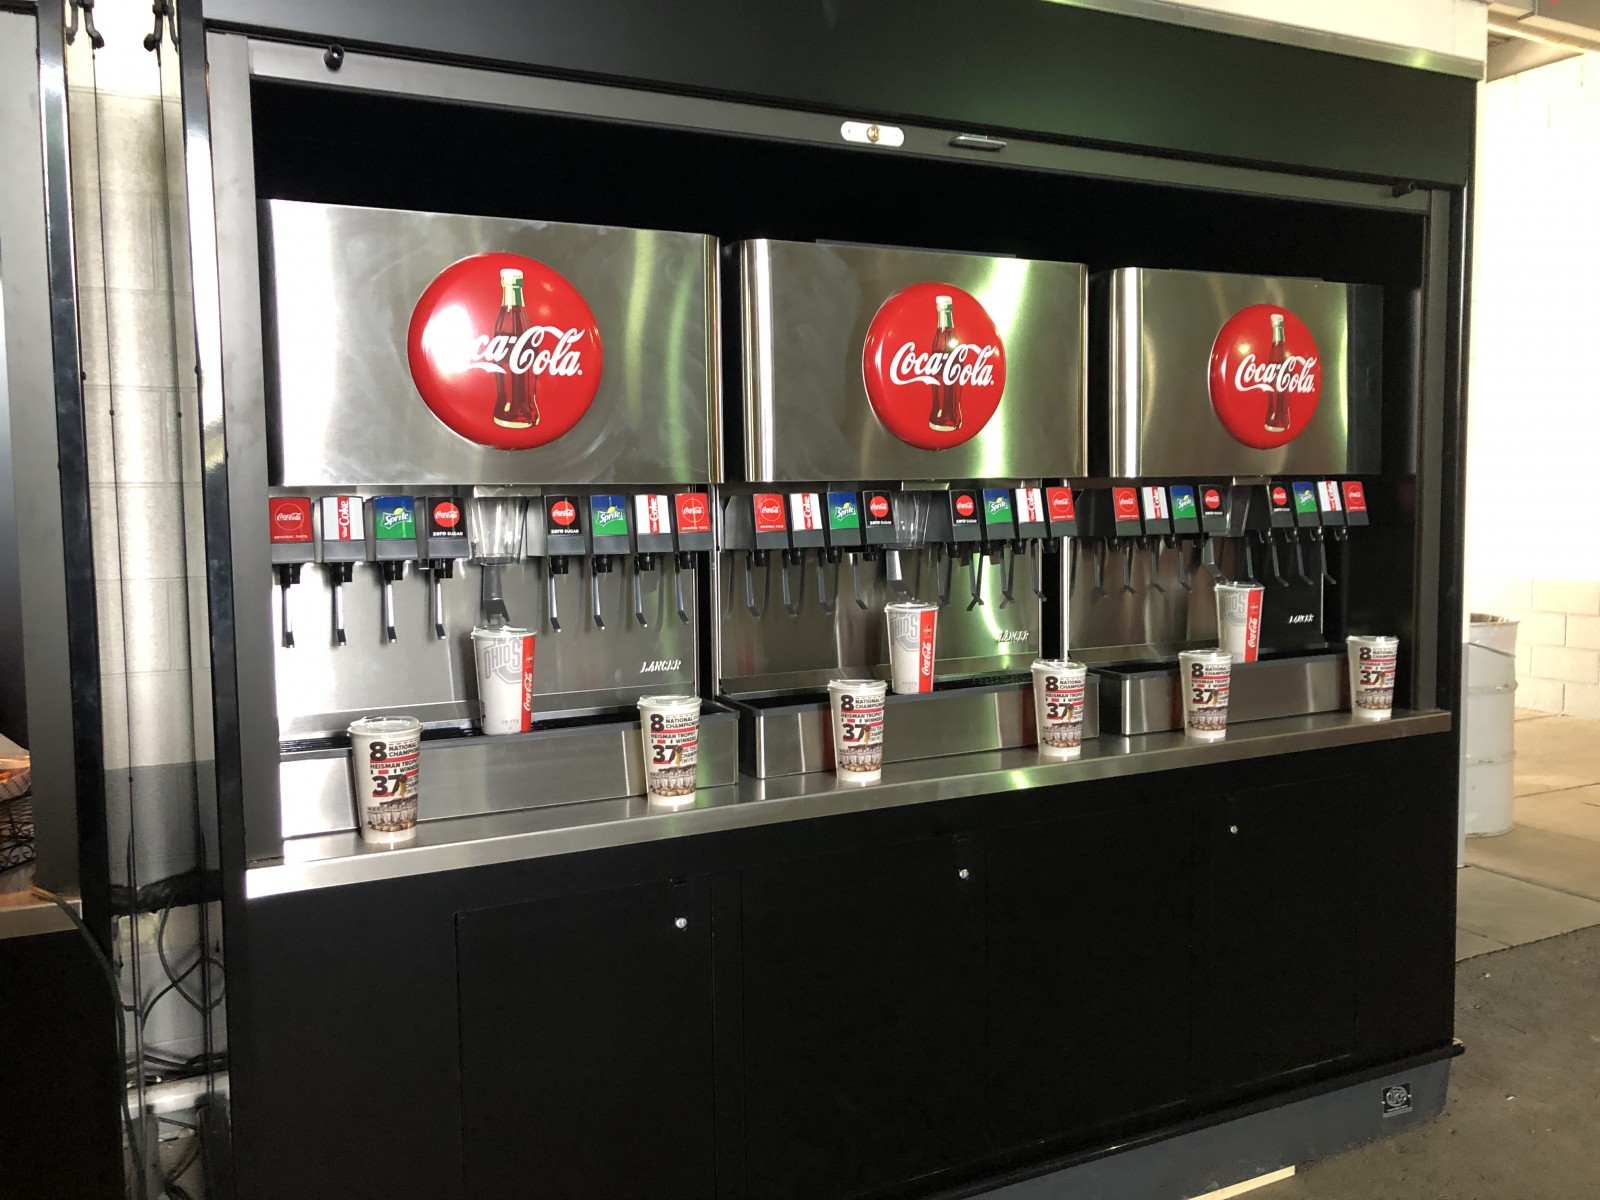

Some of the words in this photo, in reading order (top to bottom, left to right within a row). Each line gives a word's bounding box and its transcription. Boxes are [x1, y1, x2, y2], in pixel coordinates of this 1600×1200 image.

[469, 325, 586, 377] ca-Cola
[889, 341, 997, 387] Coca-Cola
[1234, 353, 1317, 393] Coca-Cola
[339, 500, 350, 526] Coke
[803, 495, 812, 518] Coke
[836, 507, 855, 518] Sprite
[990, 501, 1007, 512] Sprite
[276, 512, 302, 521] Coca-Cola
[384, 511, 409, 526] Sprite
[599, 511, 621, 523] Sprite
[1360, 647, 1371, 660] 8
[484, 644, 511, 680] OHIO
[640, 659, 682, 673] LANCER
[1192, 663, 1204, 676] 8
[1045, 676, 1058, 691] 8
[1360, 670, 1382, 684] 37
[523, 672, 533, 712] Coca-Cola
[1193, 688, 1216, 702] 37
[841, 694, 854, 711] 8
[1046, 702, 1071, 718] 37
[650, 713, 664, 731] 8
[842, 723, 868, 740] 37
[369, 741, 387, 761] 8
[389, 742, 417, 751] NATIONAL
[652, 744, 679, 762] 37
[372, 774, 403, 795] 37
